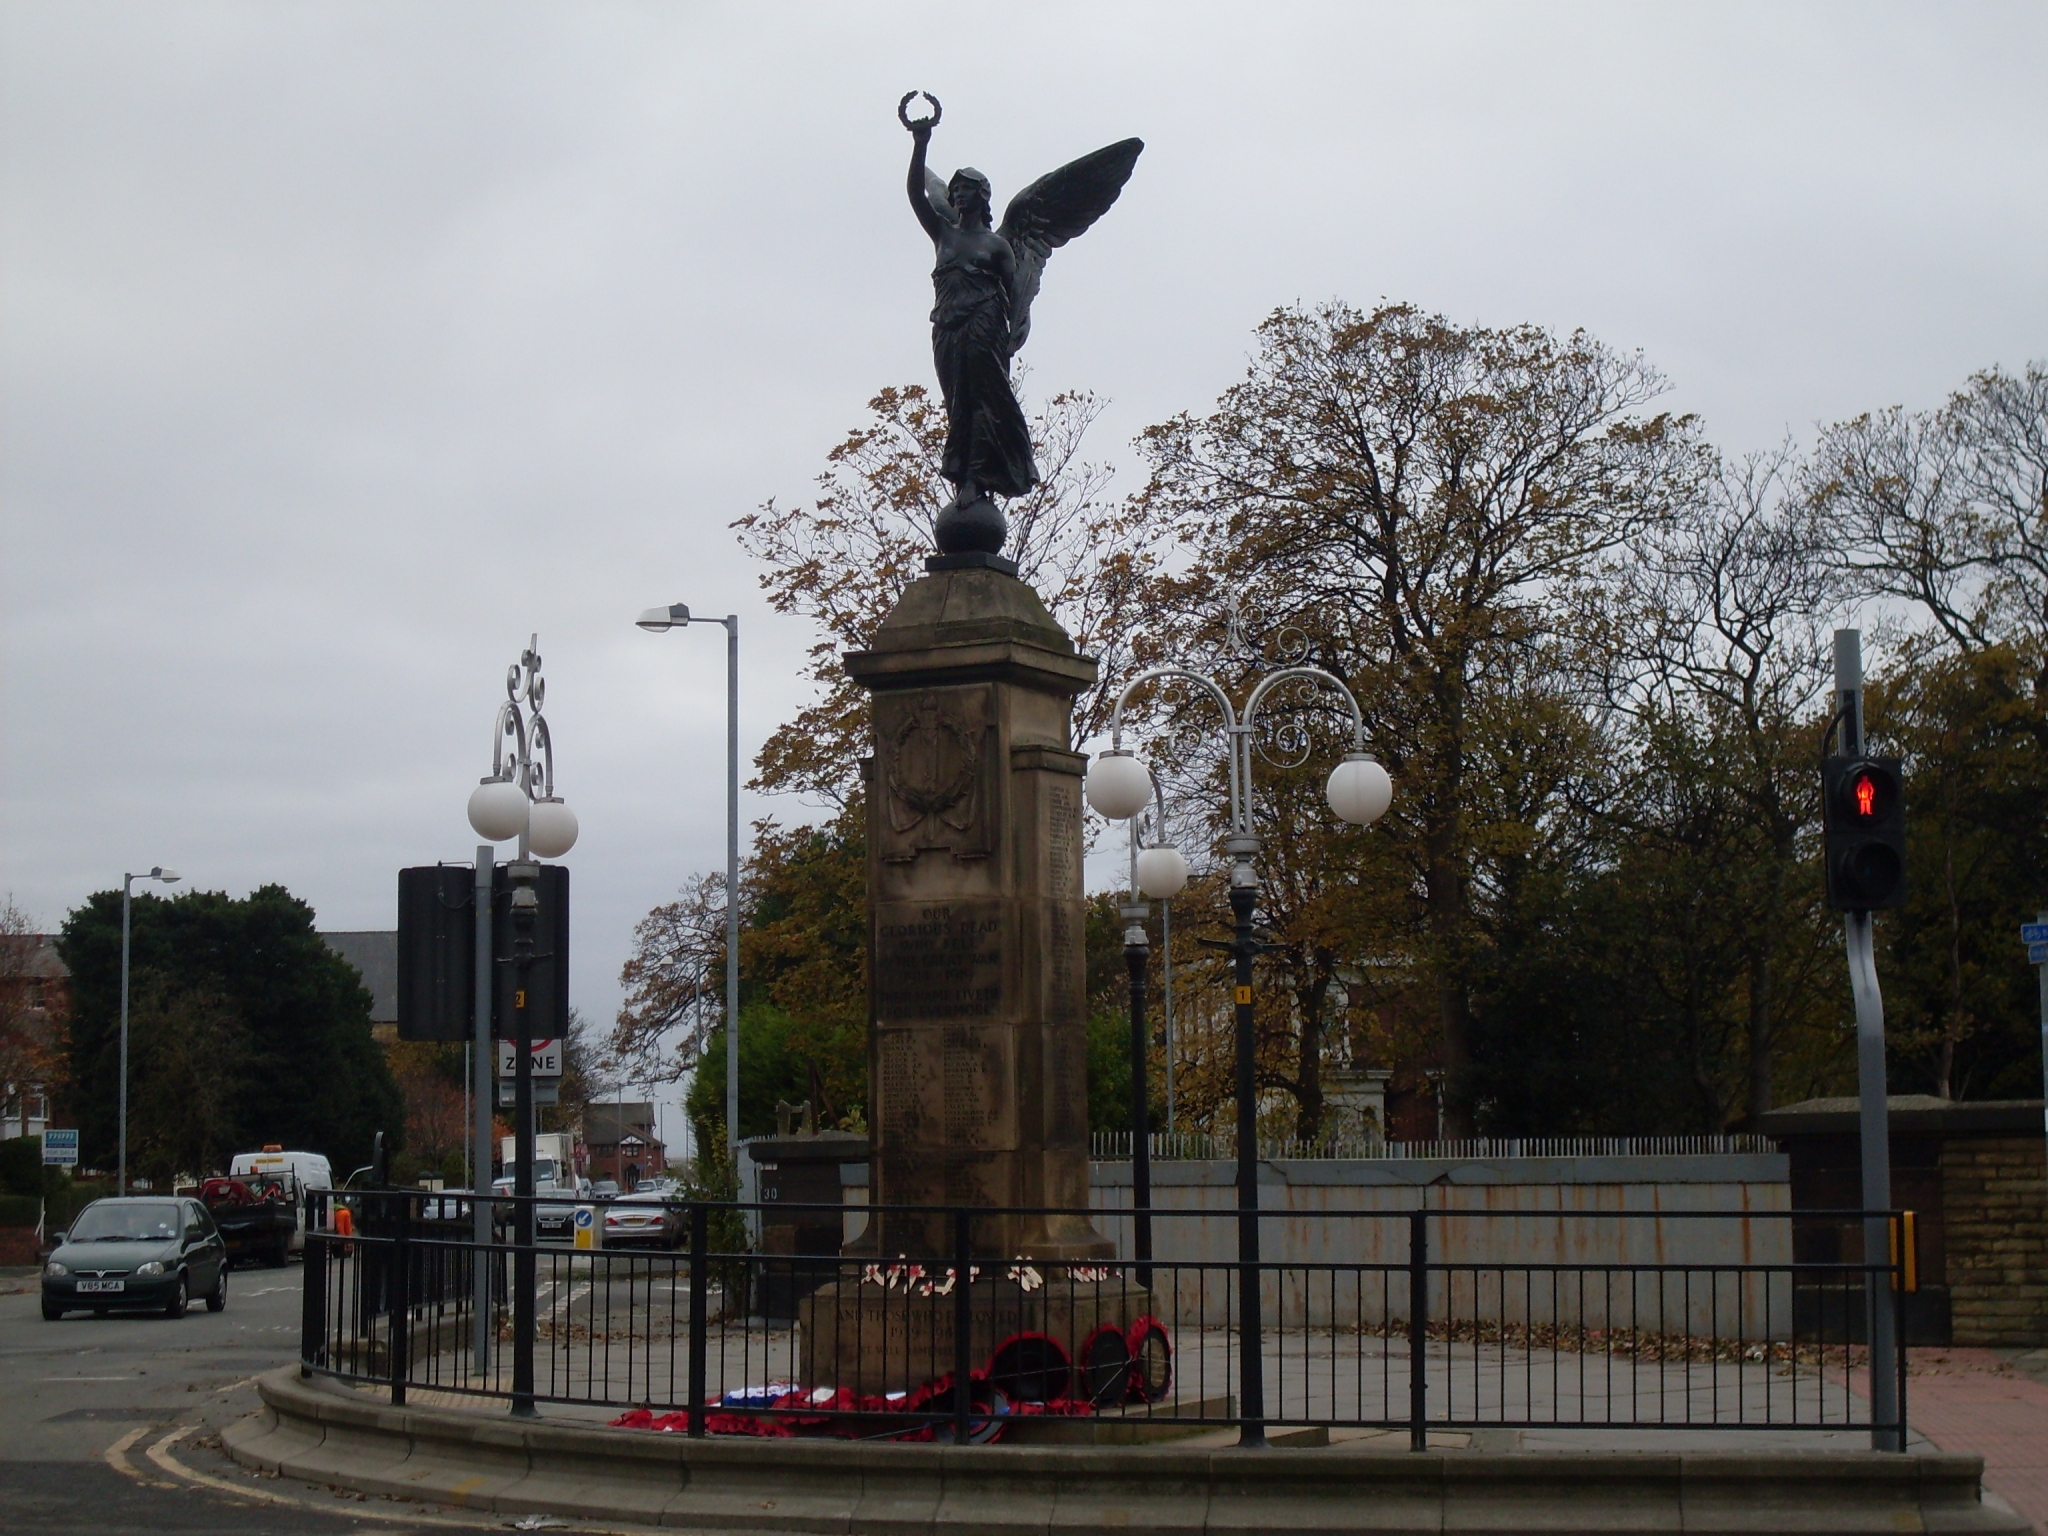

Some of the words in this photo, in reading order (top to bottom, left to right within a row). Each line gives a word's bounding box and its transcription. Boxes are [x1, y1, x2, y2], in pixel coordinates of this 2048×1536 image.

[922, 908, 950, 920] OUR
[880, 923, 952, 938] GLORIOUS
[961, 921, 997, 933] DEAD
[506, 1056, 555, 1070] ZNE
[764, 1188, 778, 1200] 30
